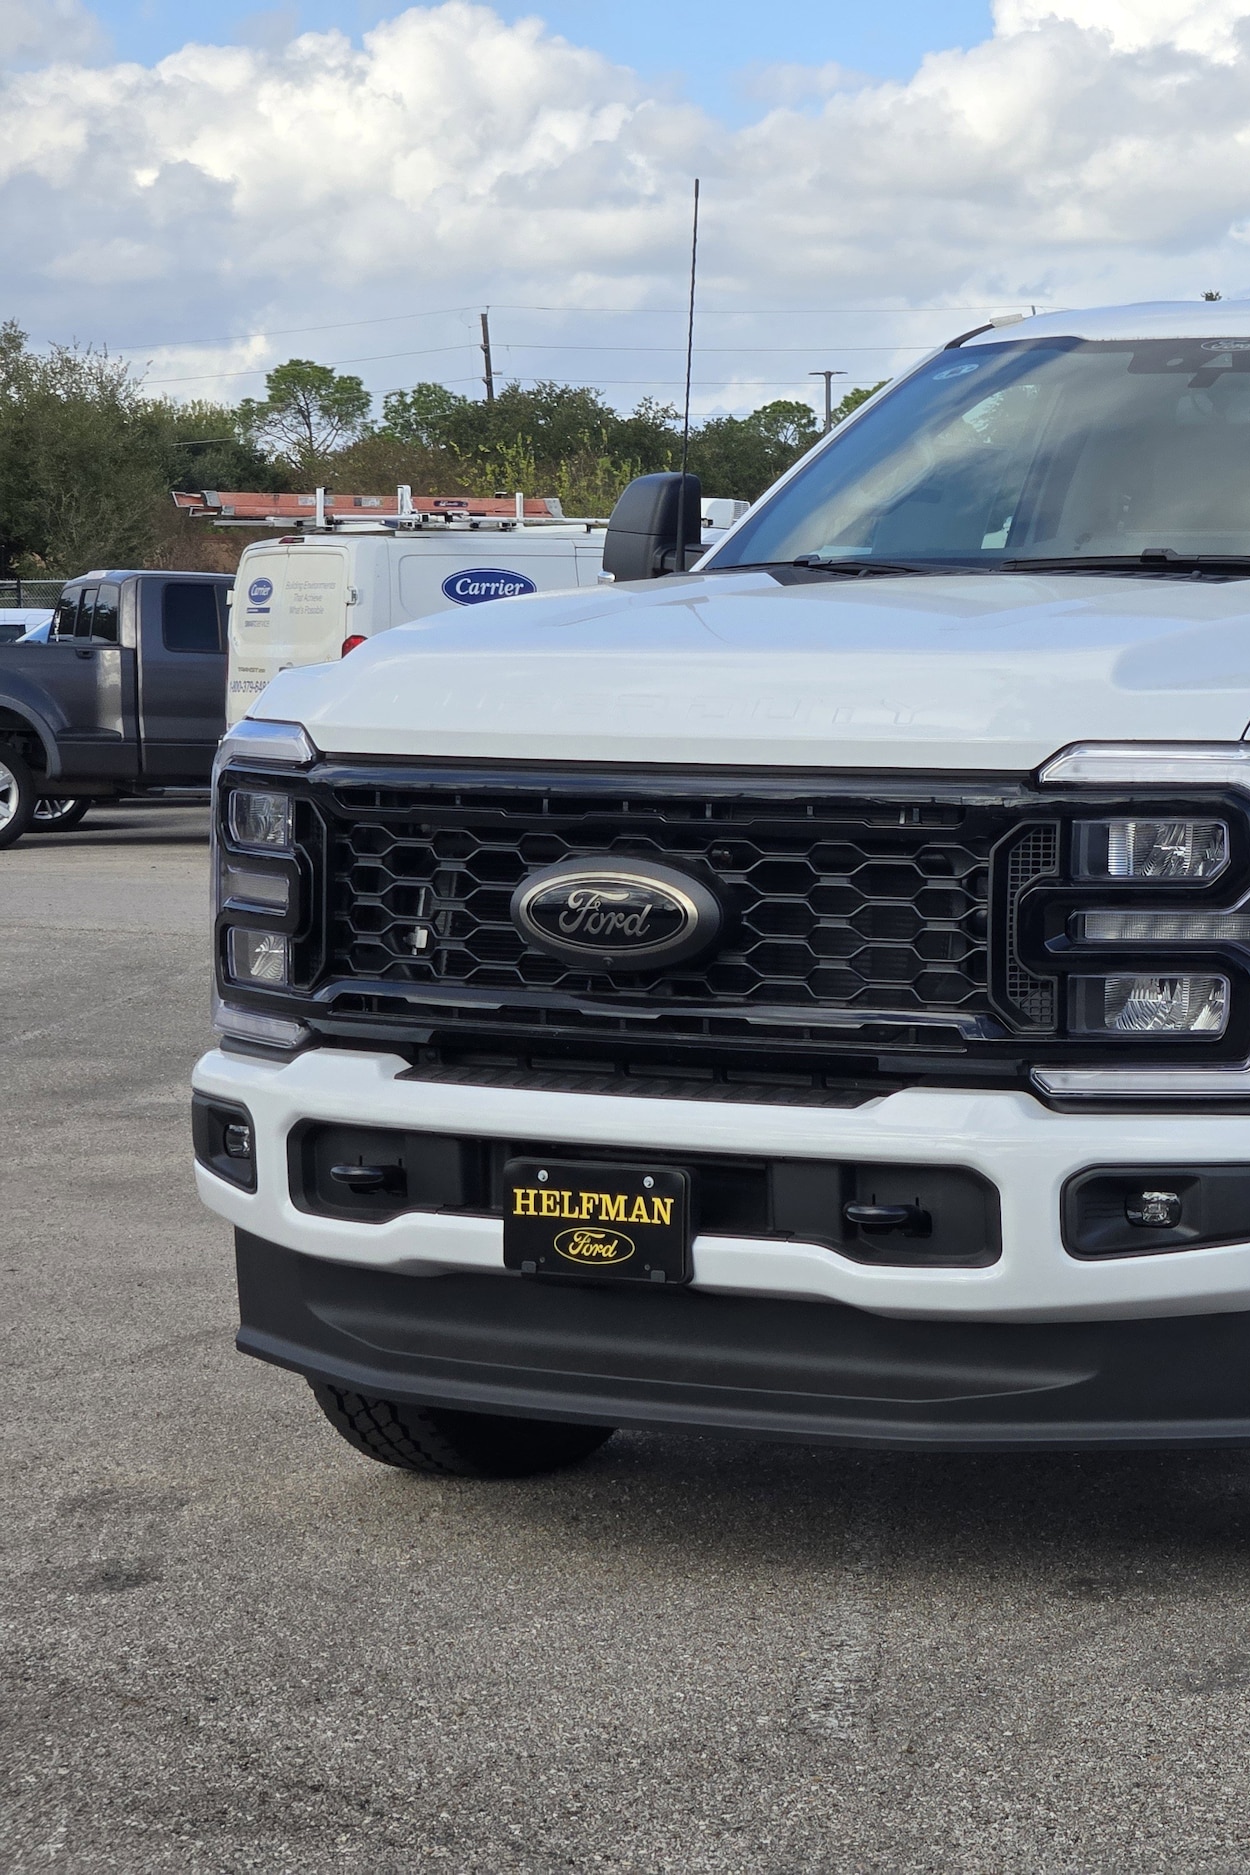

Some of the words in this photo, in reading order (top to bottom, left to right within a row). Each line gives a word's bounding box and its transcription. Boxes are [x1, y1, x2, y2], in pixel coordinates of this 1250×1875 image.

[250, 584, 271, 597] Carrier
[455, 577, 525, 597] Carrier
[558, 888, 652, 937] Ford
[512, 1188, 675, 1226] HELFMAN
[568, 1230, 619, 1258] Ford
